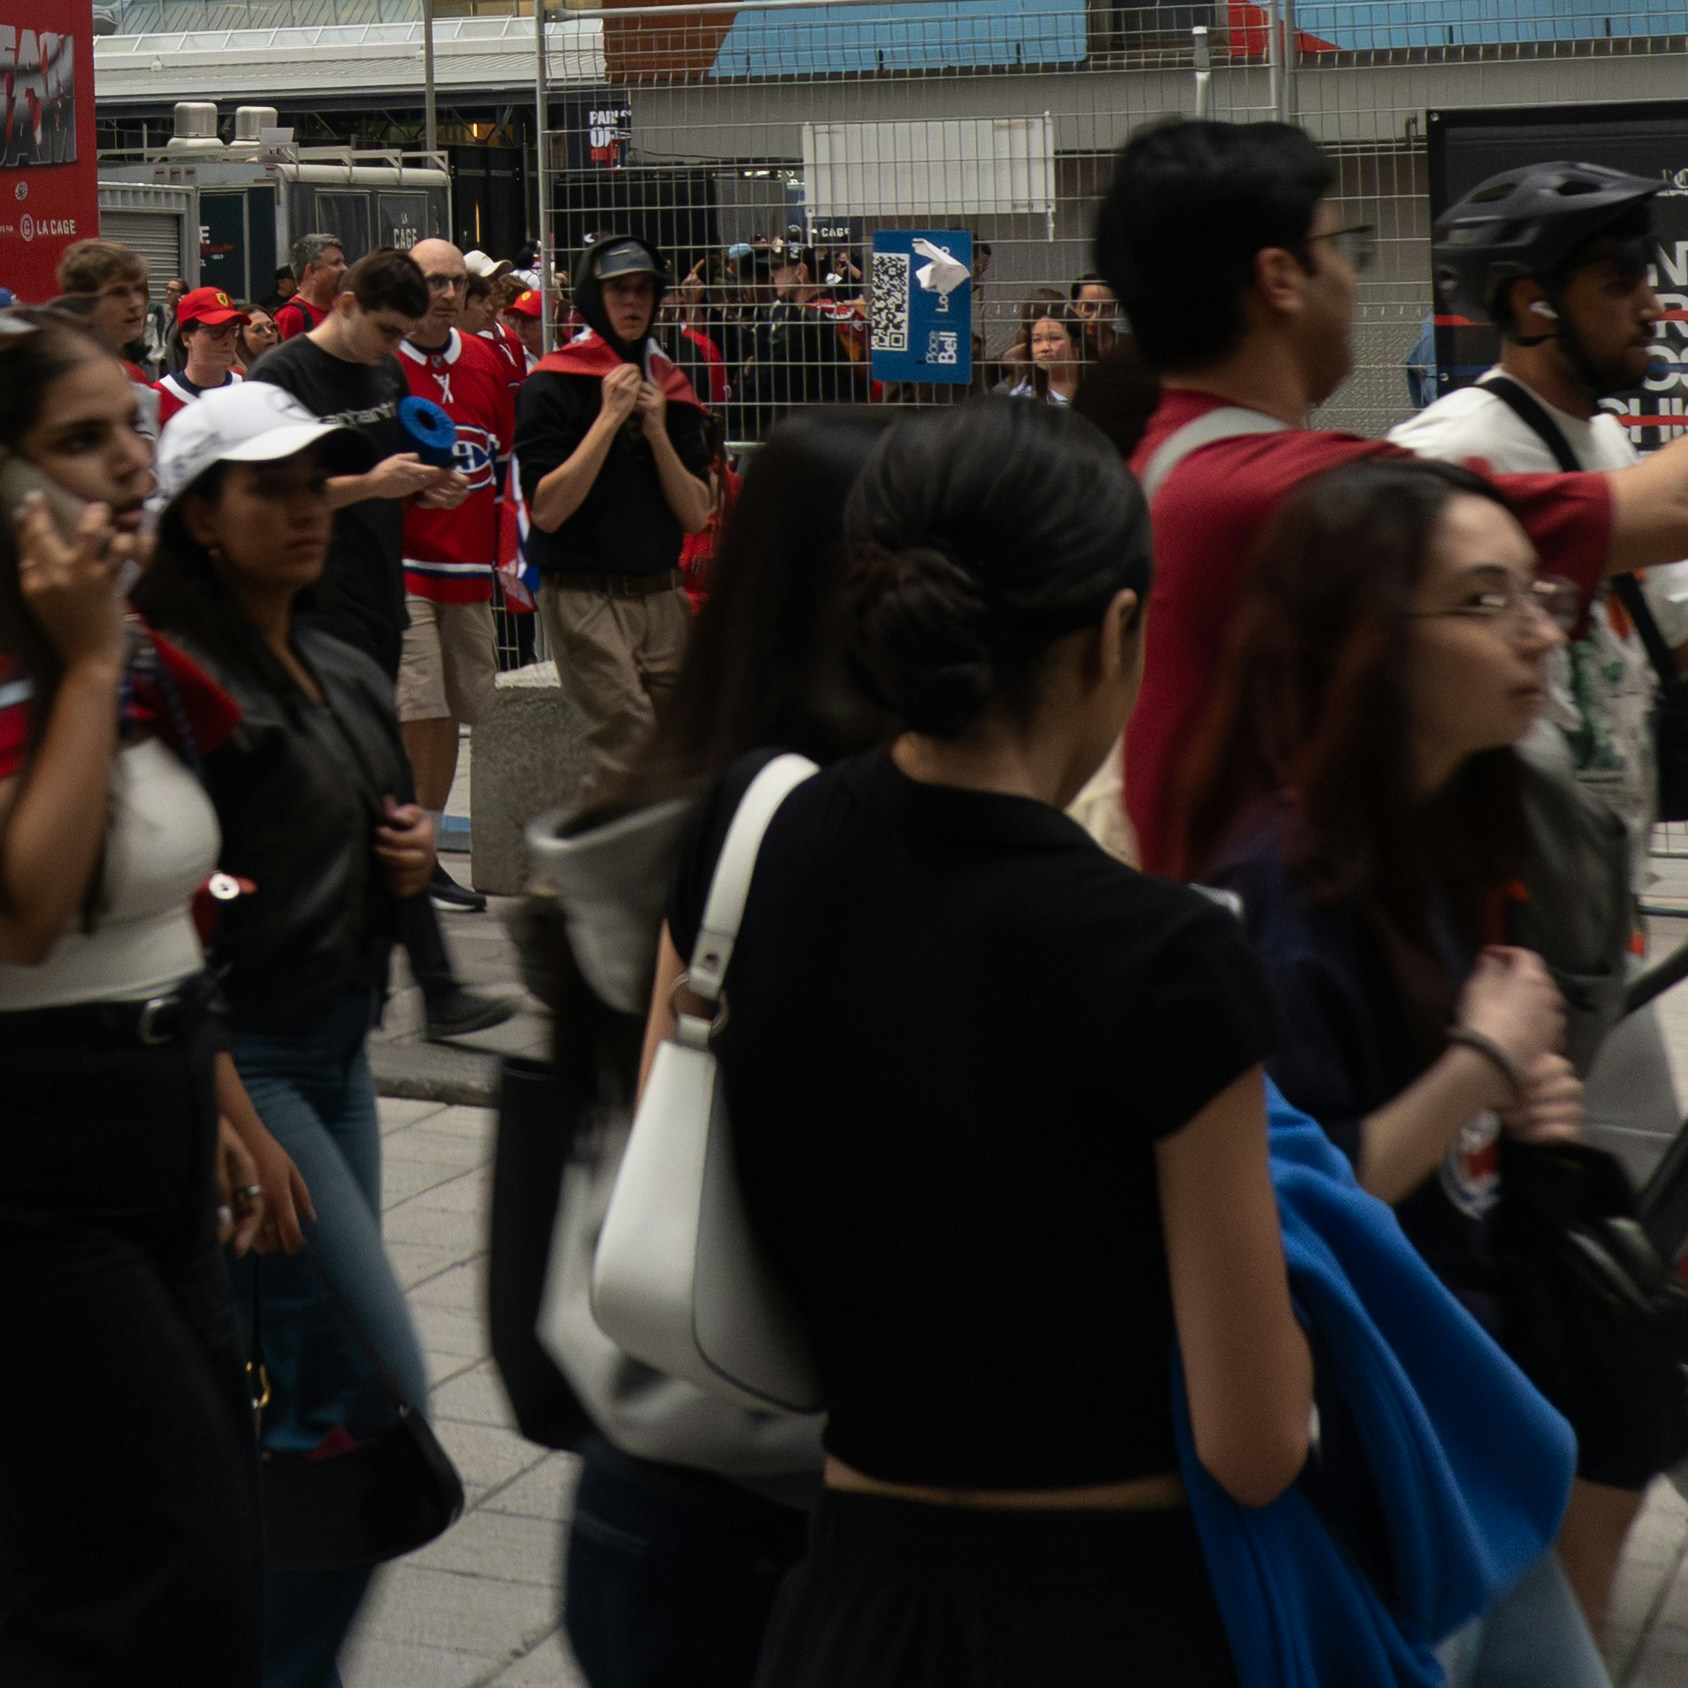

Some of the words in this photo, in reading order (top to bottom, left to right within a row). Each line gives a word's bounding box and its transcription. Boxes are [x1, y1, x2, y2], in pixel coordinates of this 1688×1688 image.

[37, 220, 49, 236] LA
[50, 219, 76, 235] CAGE
[925, 330, 939, 364] Place
[937, 330, 958, 364] Bell
